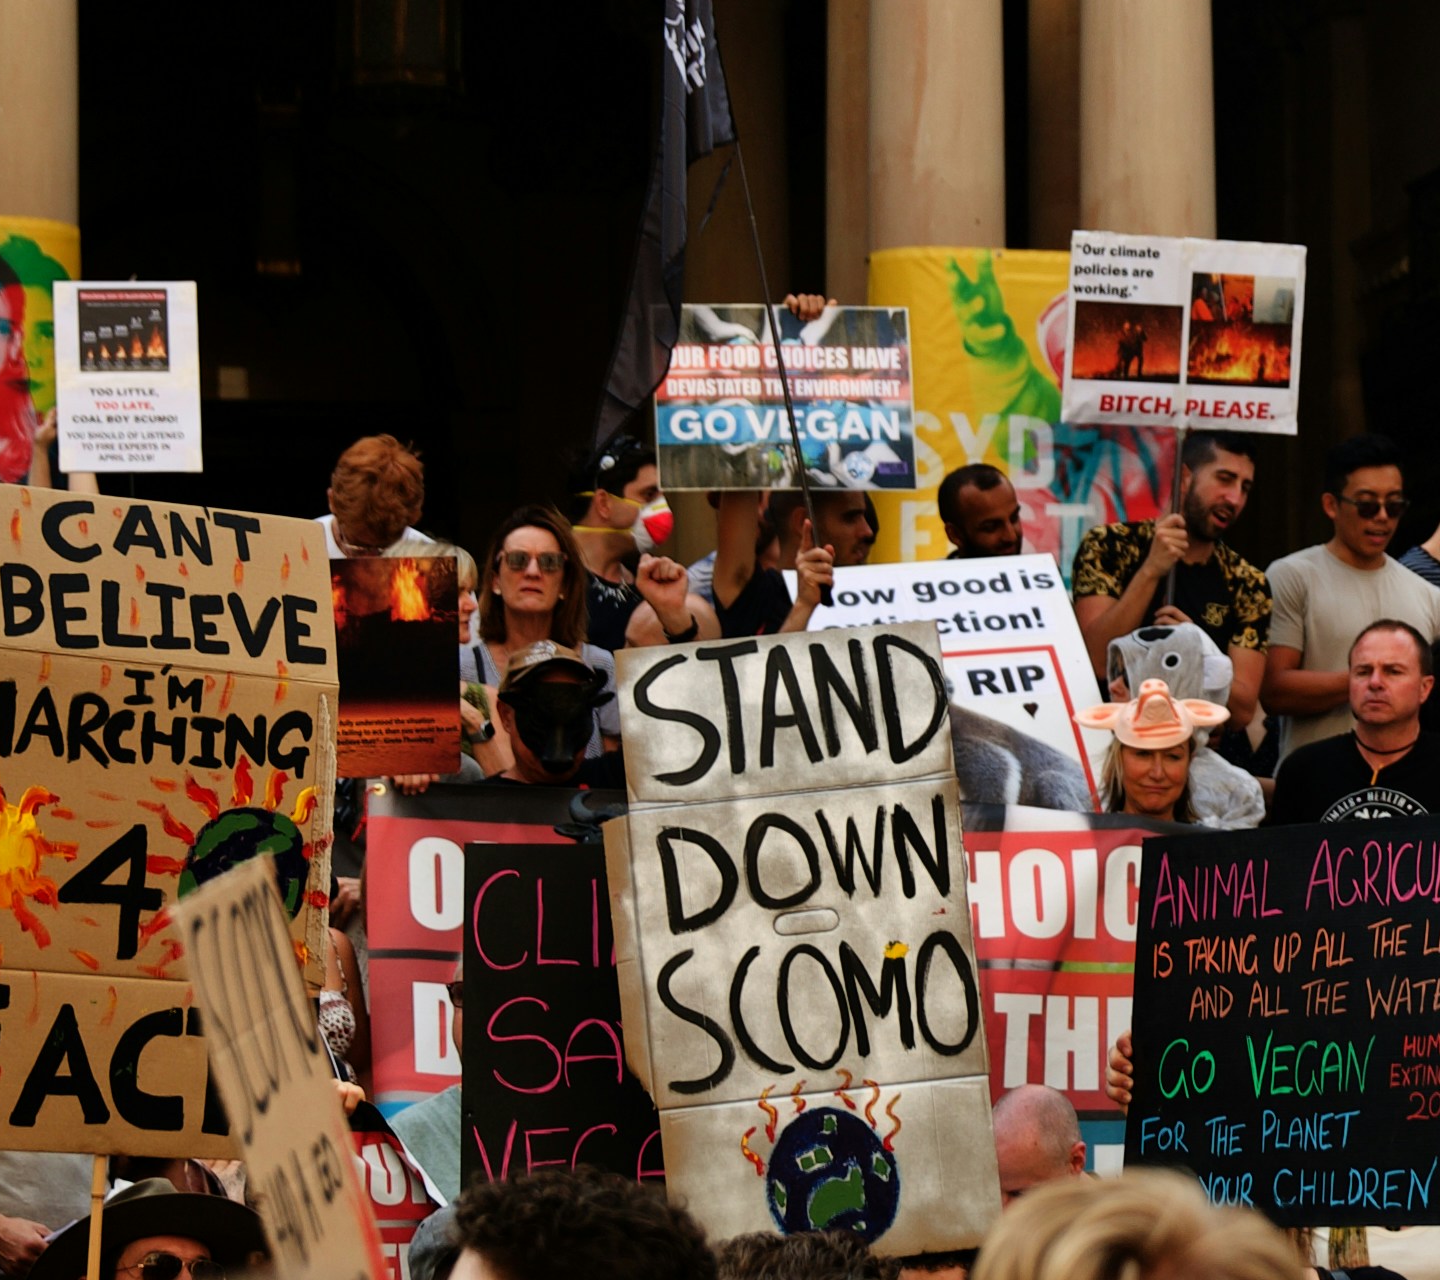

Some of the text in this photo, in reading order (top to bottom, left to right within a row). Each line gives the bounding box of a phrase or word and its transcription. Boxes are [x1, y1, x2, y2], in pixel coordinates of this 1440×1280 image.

[1074, 264, 1154, 278] policies are
[1110, 245, 1160, 259] climate
[711, 345, 760, 368] FOOD
[764, 346, 848, 369] CHOICES
[852, 346, 902, 369] HAVE
[90, 388, 113, 396] TOO
[95, 401, 119, 410] TOO
[666, 378, 901, 397] DEVASTATED THE ENVIRONMENT
[1099, 394, 1275, 420] BITCH, PLEASE.
[72, 415, 102, 423] COAL
[107, 415, 129, 423] BOY
[670, 409, 901, 441] GO VEGAN
[914, 411, 1056, 490] SYD
[41, 500, 261, 566] CAN'T
[0, 562, 327, 665] BELIEVE
[830, 570, 1055, 608] ow good is
[123, 663, 204, 713] I'M
[967, 664, 1045, 696] RIP
[633, 632, 951, 786] STAND
[1323, 797, 1356, 823] IMALS
[656, 793, 951, 936] DOWN
[58, 822, 167, 960] 4
[1151, 852, 1284, 929] ANIMAL
[473, 869, 617, 970] CLI
[1153, 941, 1173, 978] IS
[1184, 934, 1258, 975] TAKING
[1273, 931, 1301, 973] UP
[1312, 928, 1353, 971] ALL
[1368, 917, 1412, 958] THE
[656, 930, 978, 1095] SCOMO
[1189, 984, 1234, 1022] AND
[1248, 980, 1289, 1018] ALL
[1301, 978, 1349, 1017] THE
[487, 996, 624, 1094] SA
[1159, 1029, 1375, 1100] GO VEGAN
[1141, 1109, 1361, 1157] FOR THE PLANET
[1273, 1156, 1438, 1210] CHILDREN
